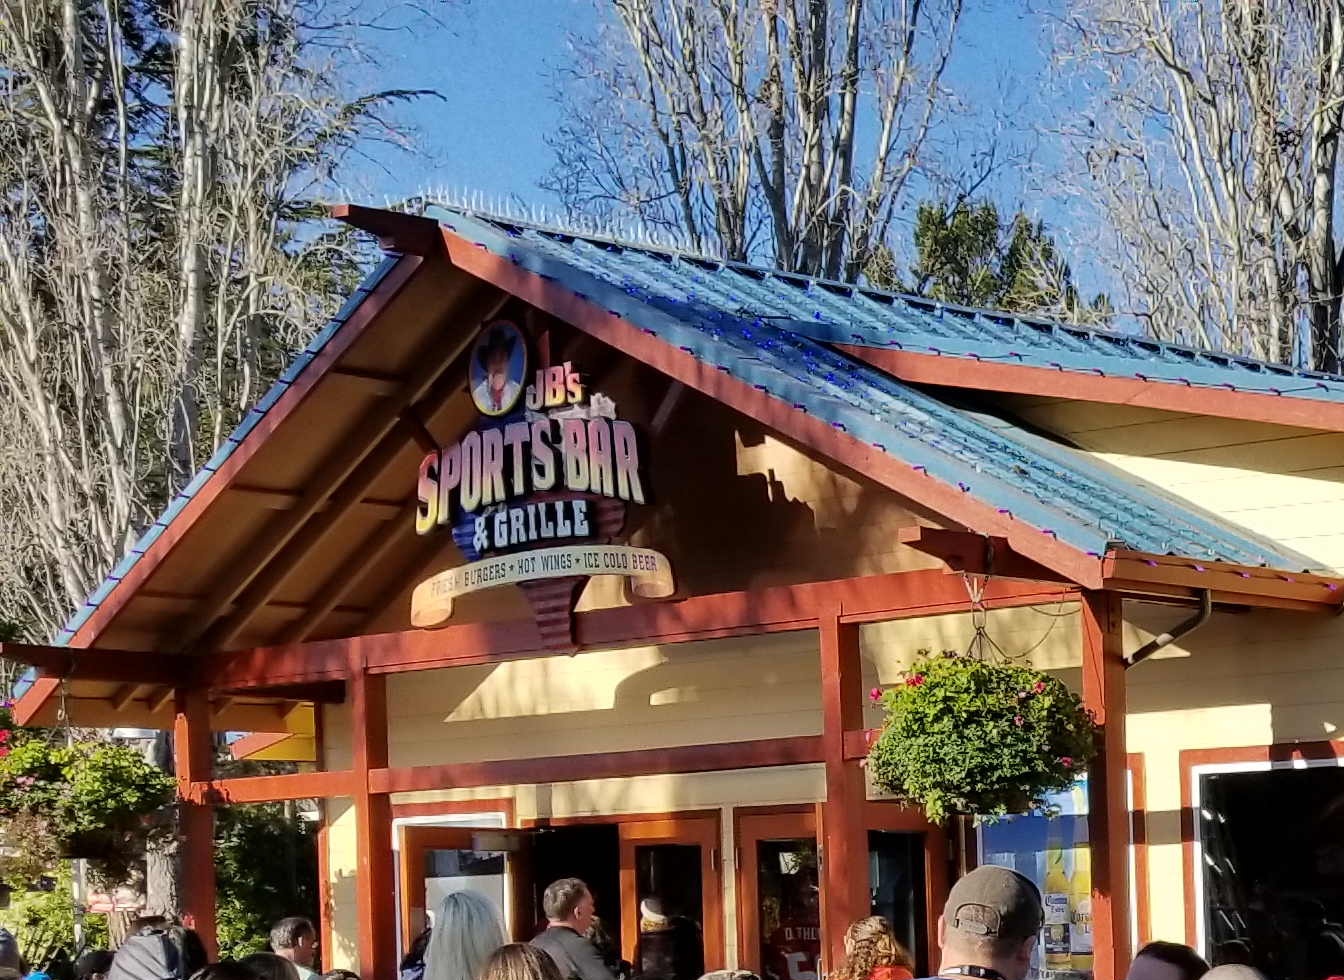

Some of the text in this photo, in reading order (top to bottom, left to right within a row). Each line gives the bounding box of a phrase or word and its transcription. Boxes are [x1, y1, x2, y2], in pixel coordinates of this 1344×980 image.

[526, 361, 582, 411] JB's
[416, 418, 645, 535] SPORTS BAR
[473, 500, 590, 553] & GRILLE
[464, 564, 506, 587] BURGERS
[517, 558, 536, 575] HOT
[541, 553, 572, 572] WINGS
[583, 552, 600, 569] ICE
[603, 552, 628, 569] COLD
[632, 554, 658, 572] BEER
